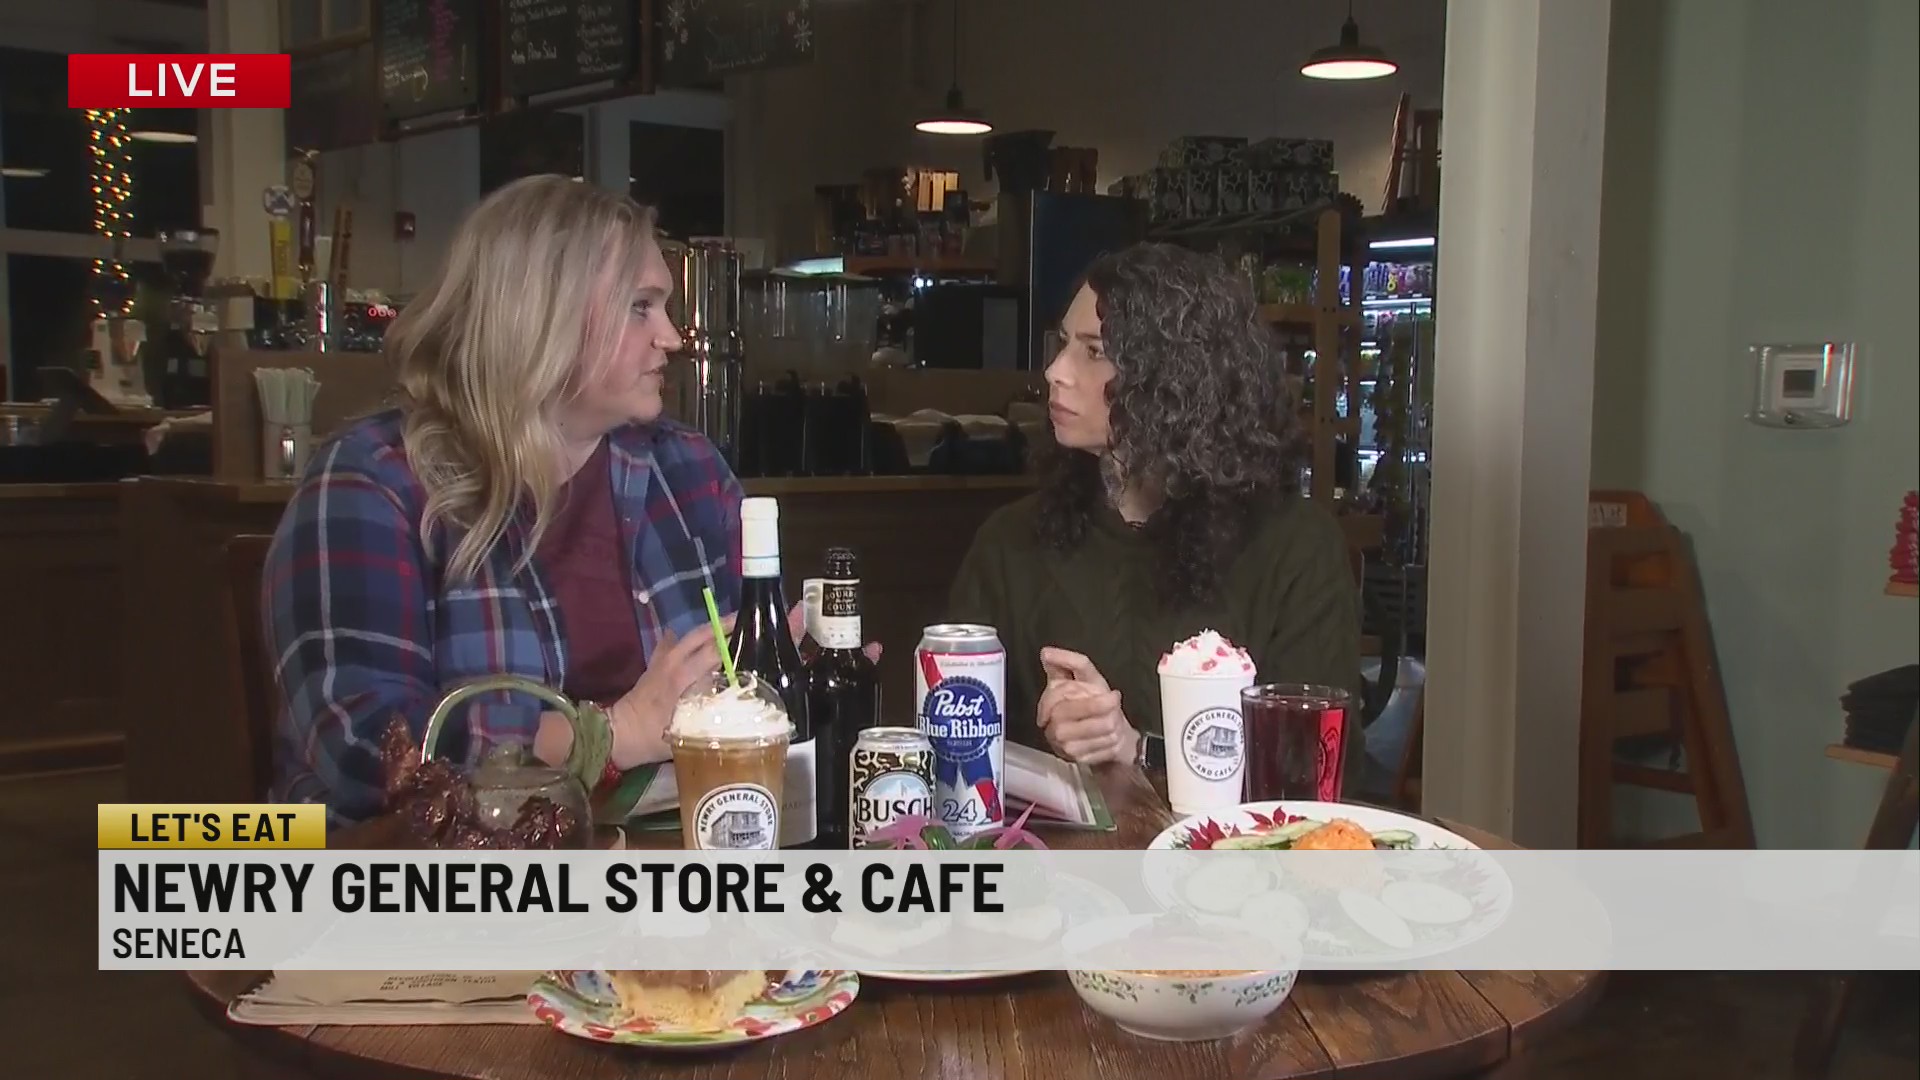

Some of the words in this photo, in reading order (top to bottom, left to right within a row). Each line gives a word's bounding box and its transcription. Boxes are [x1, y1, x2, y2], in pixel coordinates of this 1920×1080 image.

[933, 690, 985, 717] Pabst
[918, 716, 949, 738] Blue
[950, 719, 1001, 738] Ribbon
[1196, 764, 1213, 776] AND
[701, 803, 716, 832] NEWRY
[716, 793, 760, 806] GENERAL
[760, 800, 773, 826] STORE
[858, 797, 933, 822] BUSCH
[942, 798, 977, 822] 24
